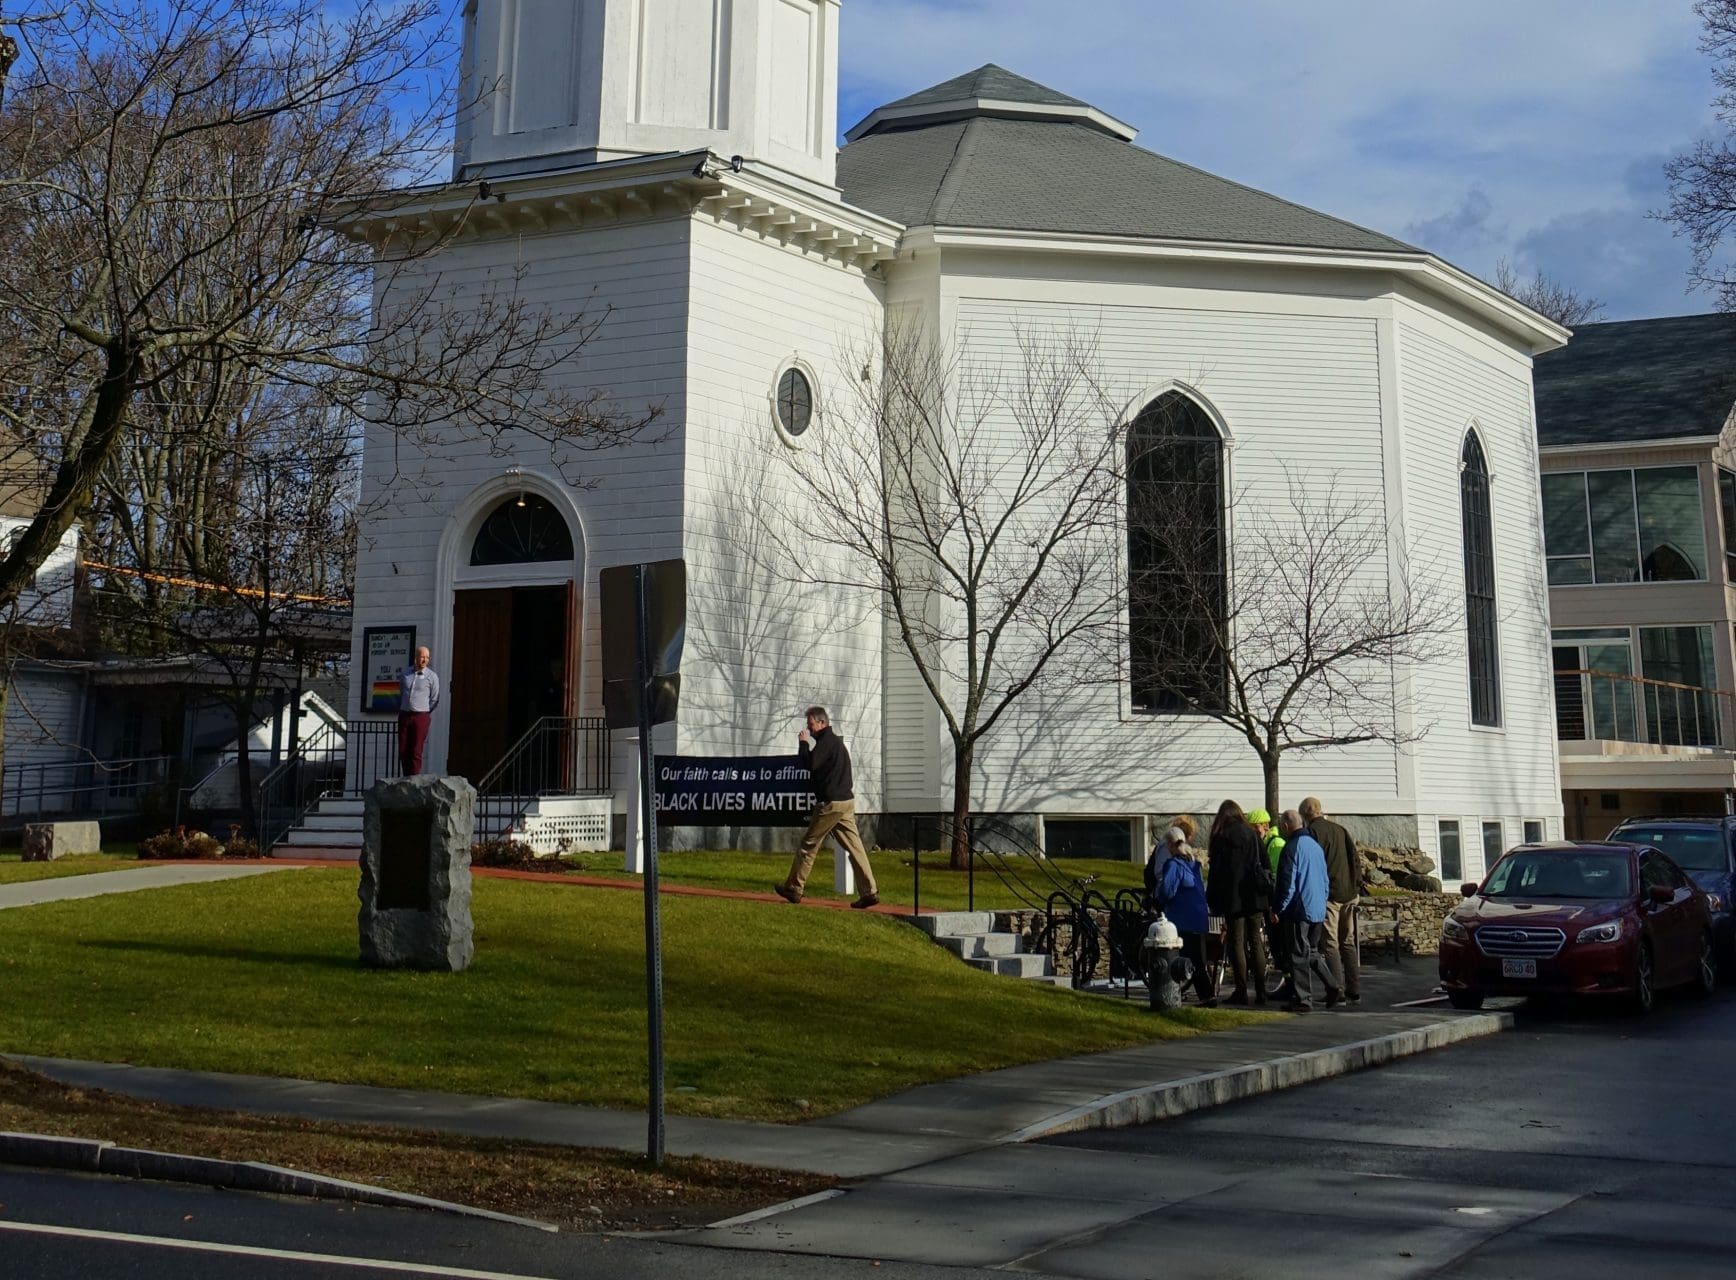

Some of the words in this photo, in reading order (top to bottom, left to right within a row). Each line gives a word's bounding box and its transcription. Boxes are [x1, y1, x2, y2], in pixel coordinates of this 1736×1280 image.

[661, 766, 682, 781] Our
[684, 766, 709, 781] faith
[711, 766, 738, 781] calls
[742, 769, 756, 781] us
[760, 767, 772, 780] to
[775, 765, 811, 780] affirm
[655, 792, 698, 811] BLACK
[703, 792, 745, 811] LIVES
[751, 792, 817, 811] MATTER
